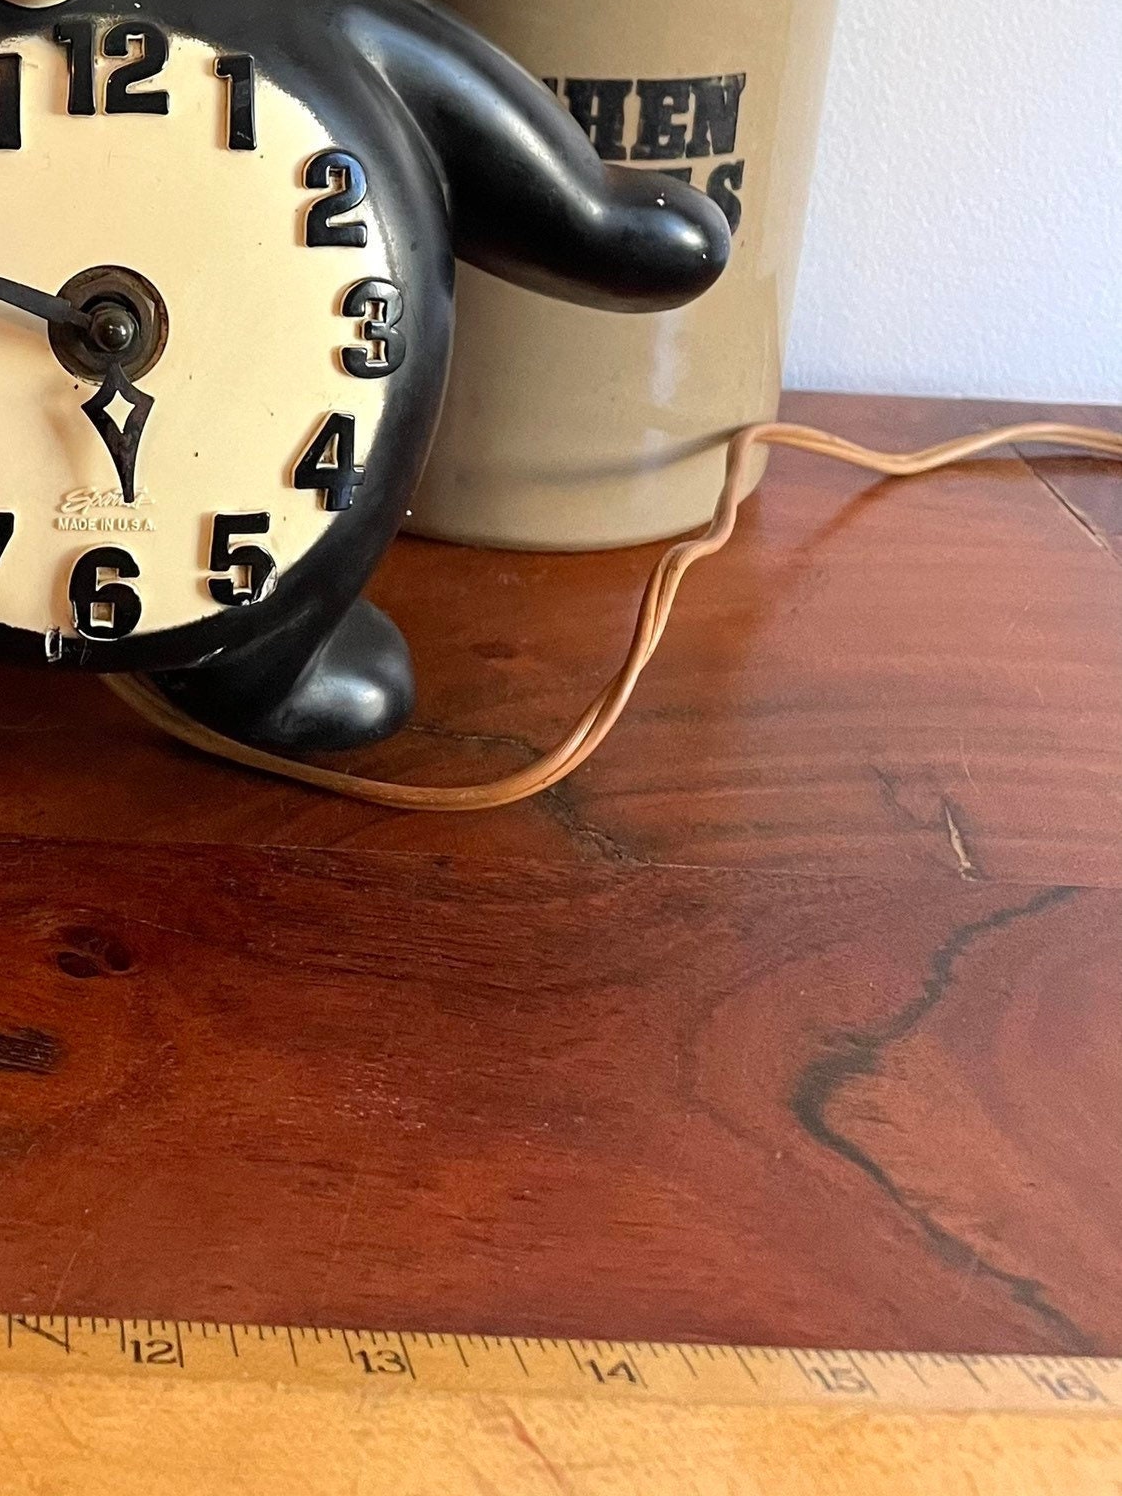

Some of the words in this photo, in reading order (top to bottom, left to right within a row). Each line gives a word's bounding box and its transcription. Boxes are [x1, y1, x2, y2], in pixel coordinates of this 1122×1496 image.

[54, 20, 170, 117] 12
[214, 53, 256, 151] 1
[303, 148, 369, 248] 2
[340, 278, 407, 379] 3
[291, 411, 366, 511] 4
[57, 517, 98, 531] MADE
[101, 517, 114, 531] IN
[117, 517, 158, 531] U.S.A.
[207, 512, 277, 605] 5
[68, 545, 143, 640] 6
[131, 1339, 178, 1365] 12
[356, 1348, 407, 1375] 13
[586, 1359, 637, 1384] 14
[812, 1366, 868, 1394] 15
[1038, 1372, 1098, 1401] 16
